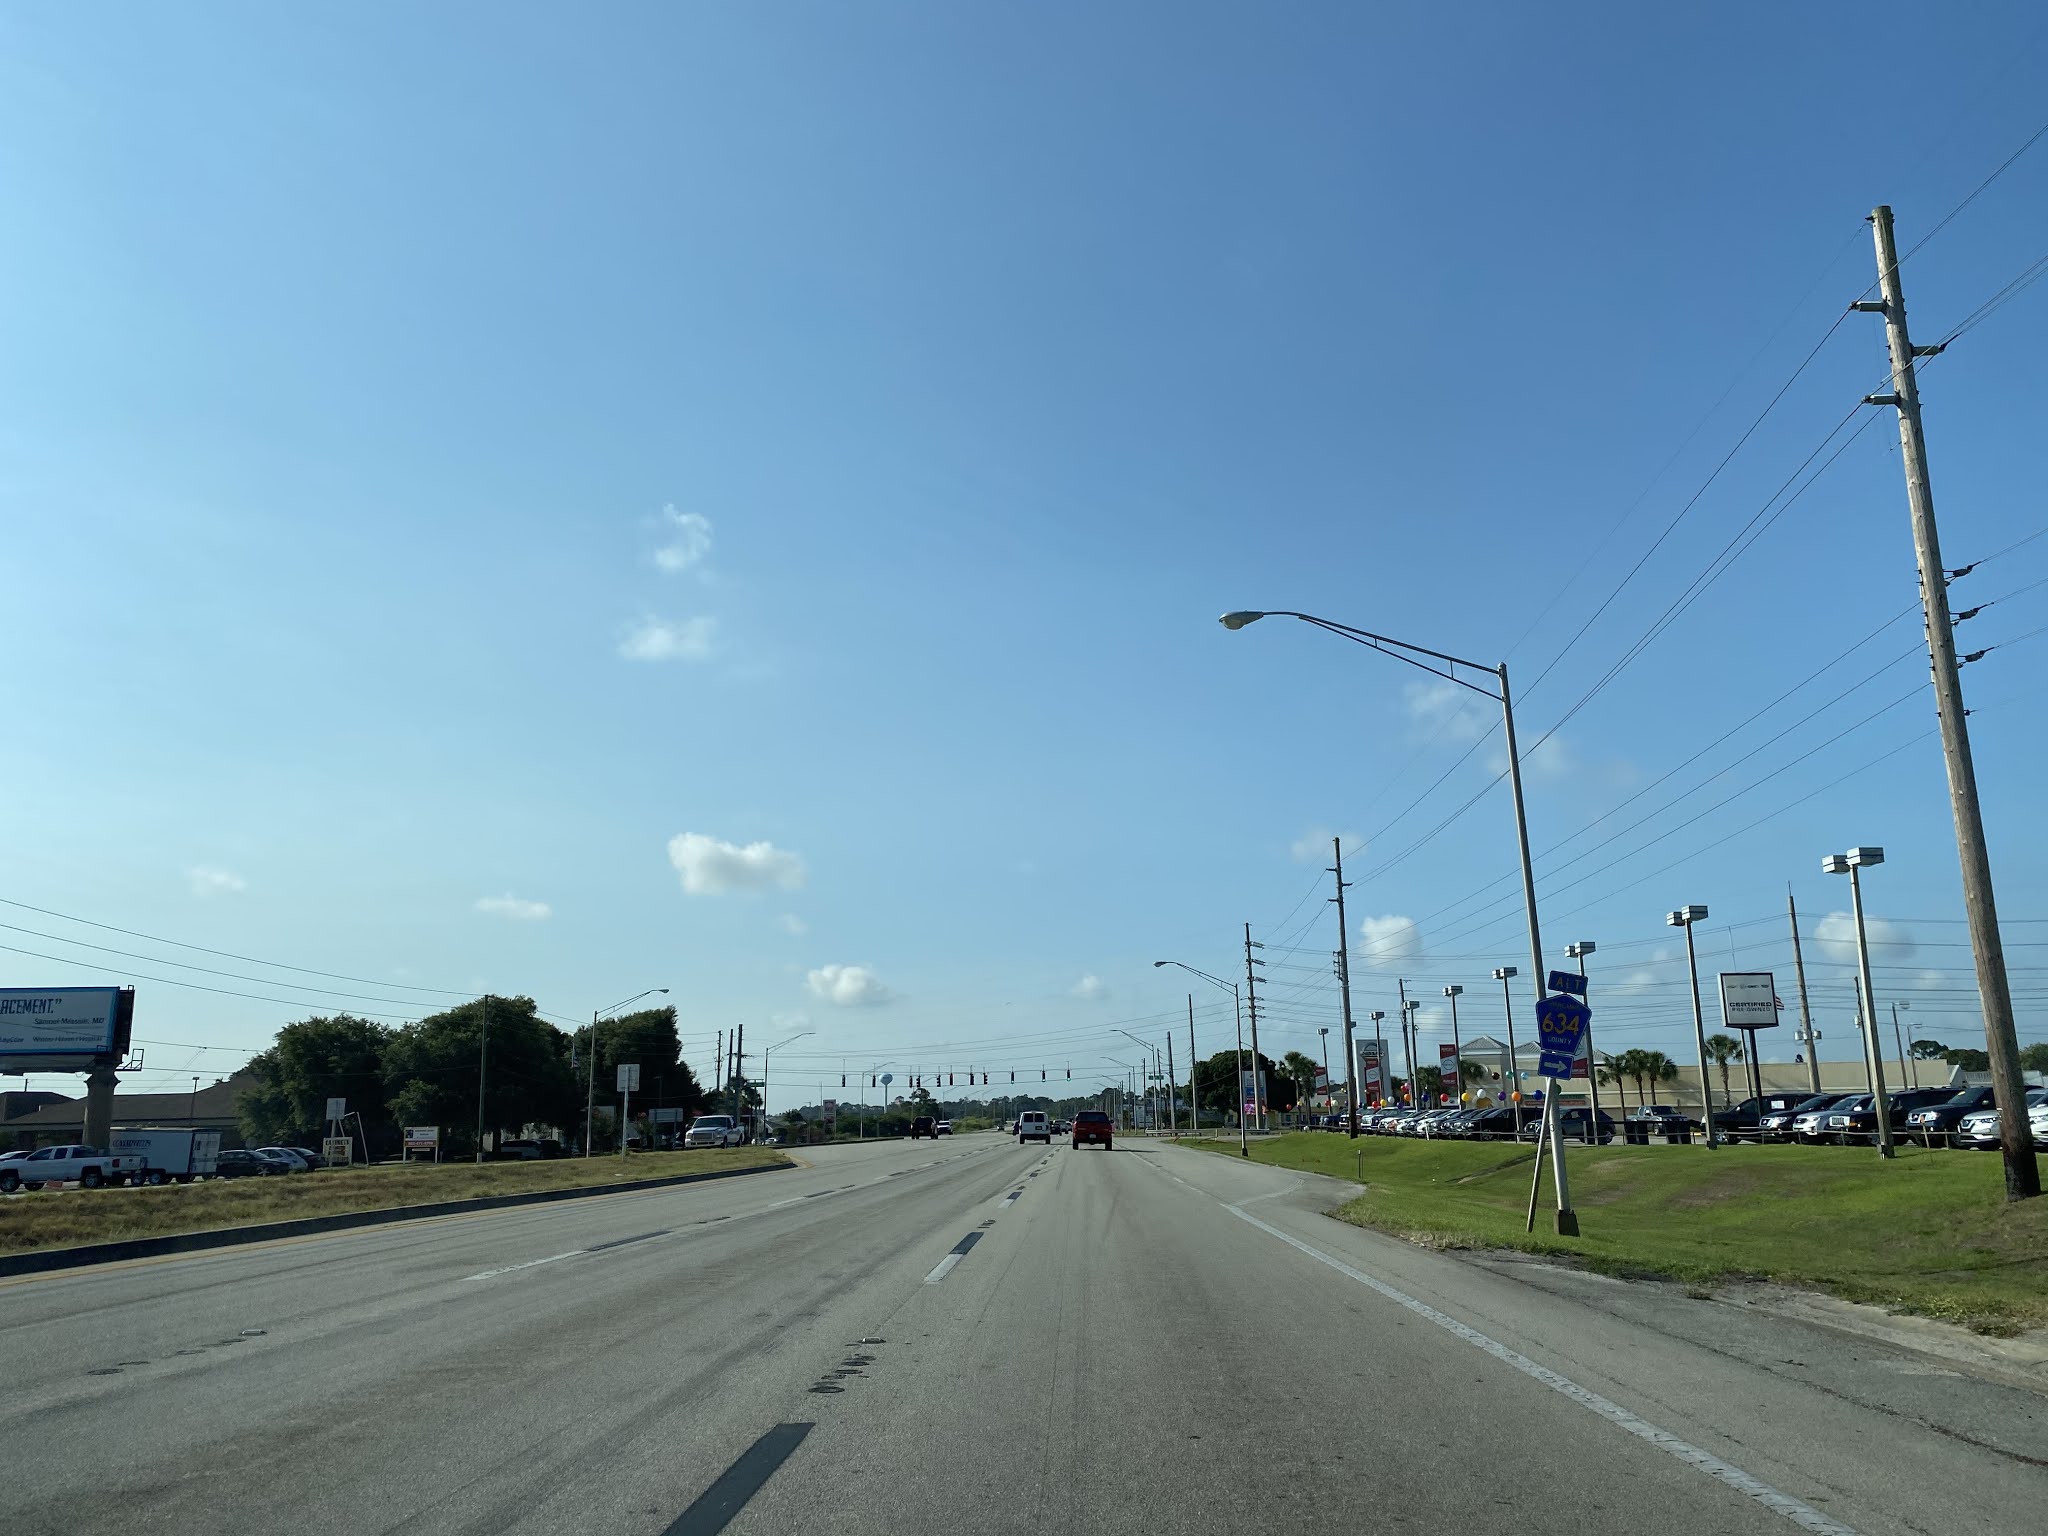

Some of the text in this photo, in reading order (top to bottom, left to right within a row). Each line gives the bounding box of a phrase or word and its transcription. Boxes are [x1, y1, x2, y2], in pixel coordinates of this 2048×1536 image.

[1556, 976, 1582, 990] ALT
[0, 998, 62, 1015] ACEMENT.”
[1542, 1012, 1580, 1036] 634
[1548, 1036, 1572, 1045] COUNTY
